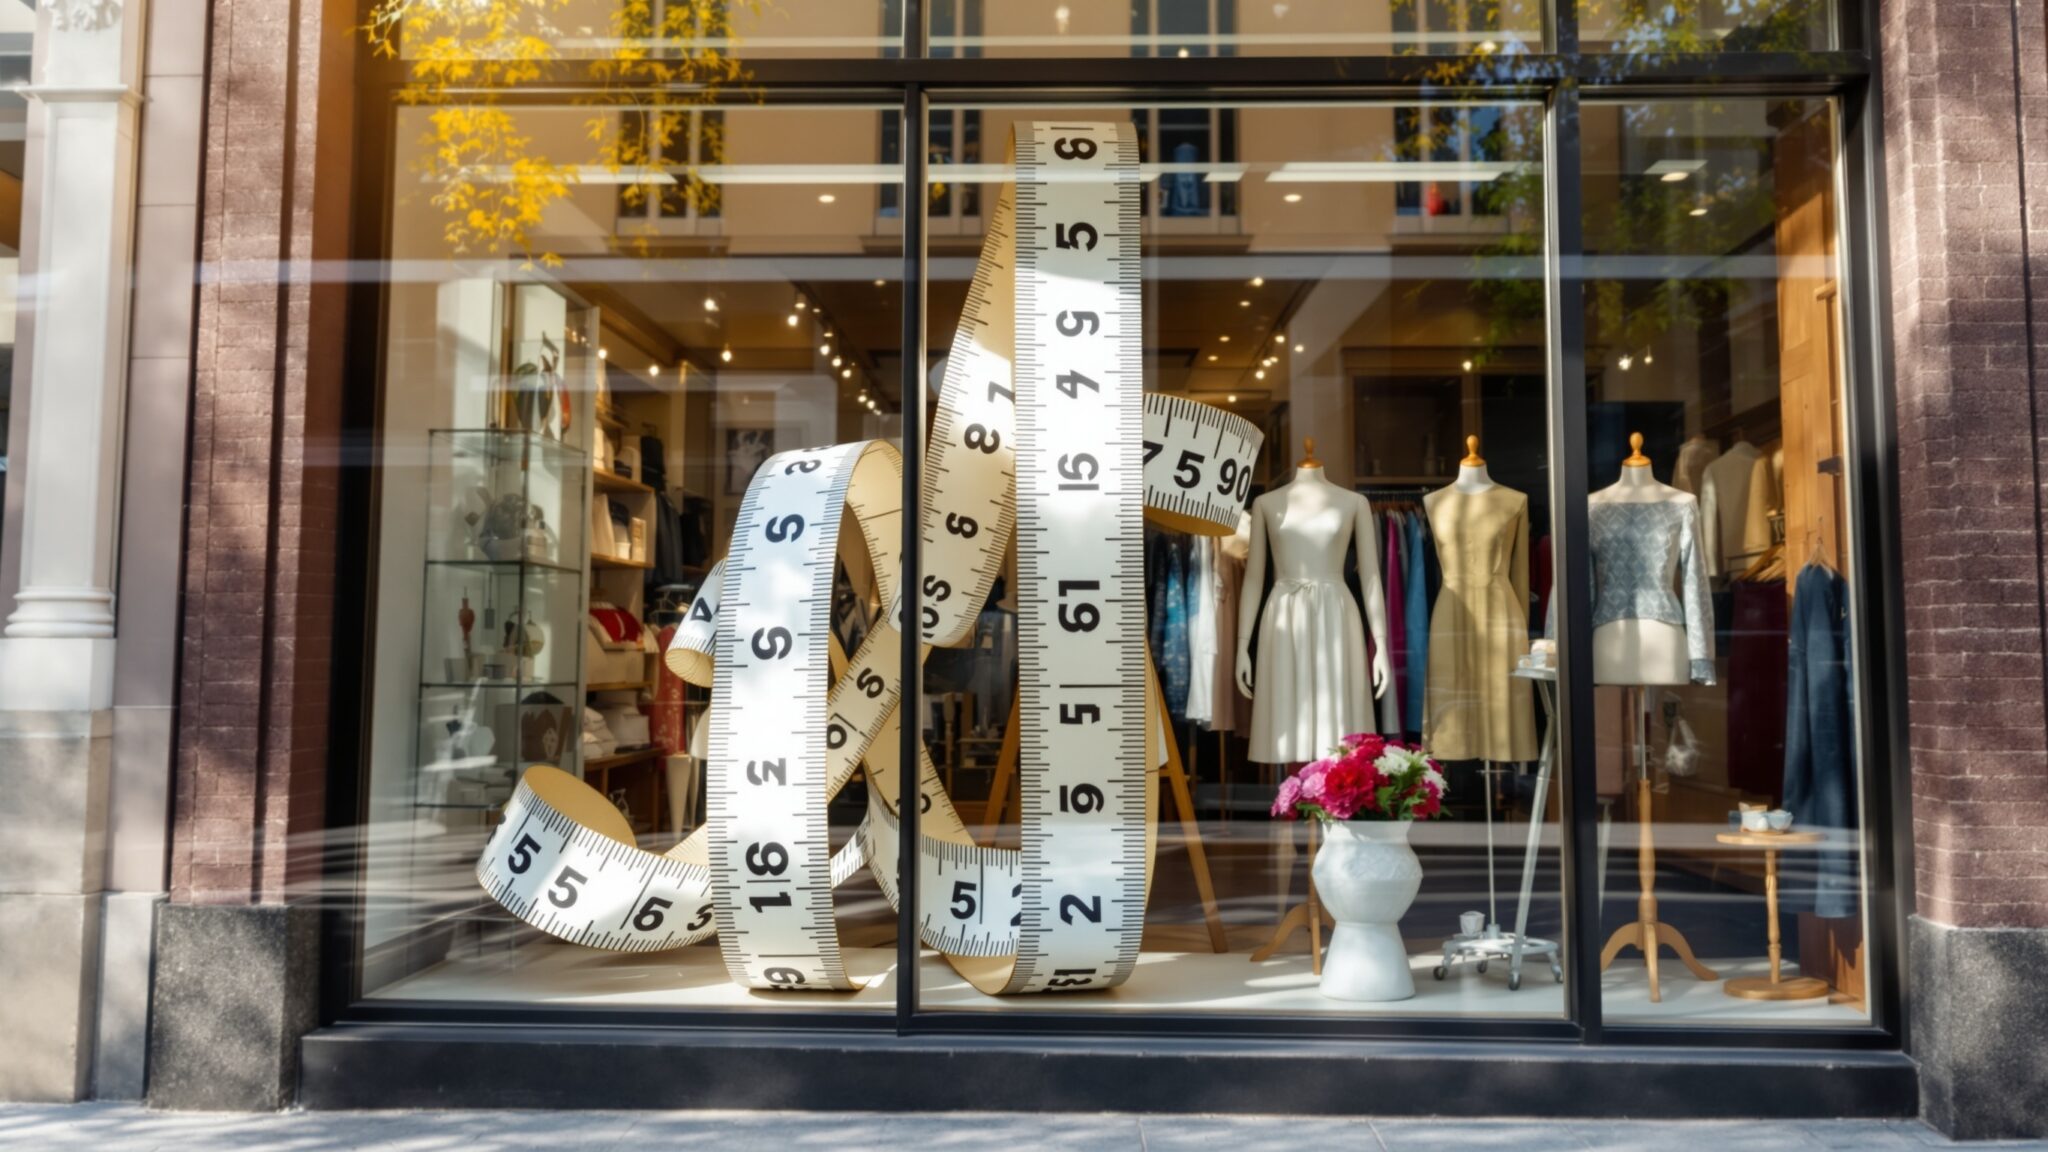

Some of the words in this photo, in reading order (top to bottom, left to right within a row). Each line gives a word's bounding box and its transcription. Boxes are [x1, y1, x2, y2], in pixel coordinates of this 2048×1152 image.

[1055, 222, 1098, 251] 5
[1173, 449, 1205, 489] 5
[508, 833, 542, 874] 5
[548, 865, 588, 909] 5
[950, 881, 977, 919] 5
[1059, 894, 1101, 925] 2
